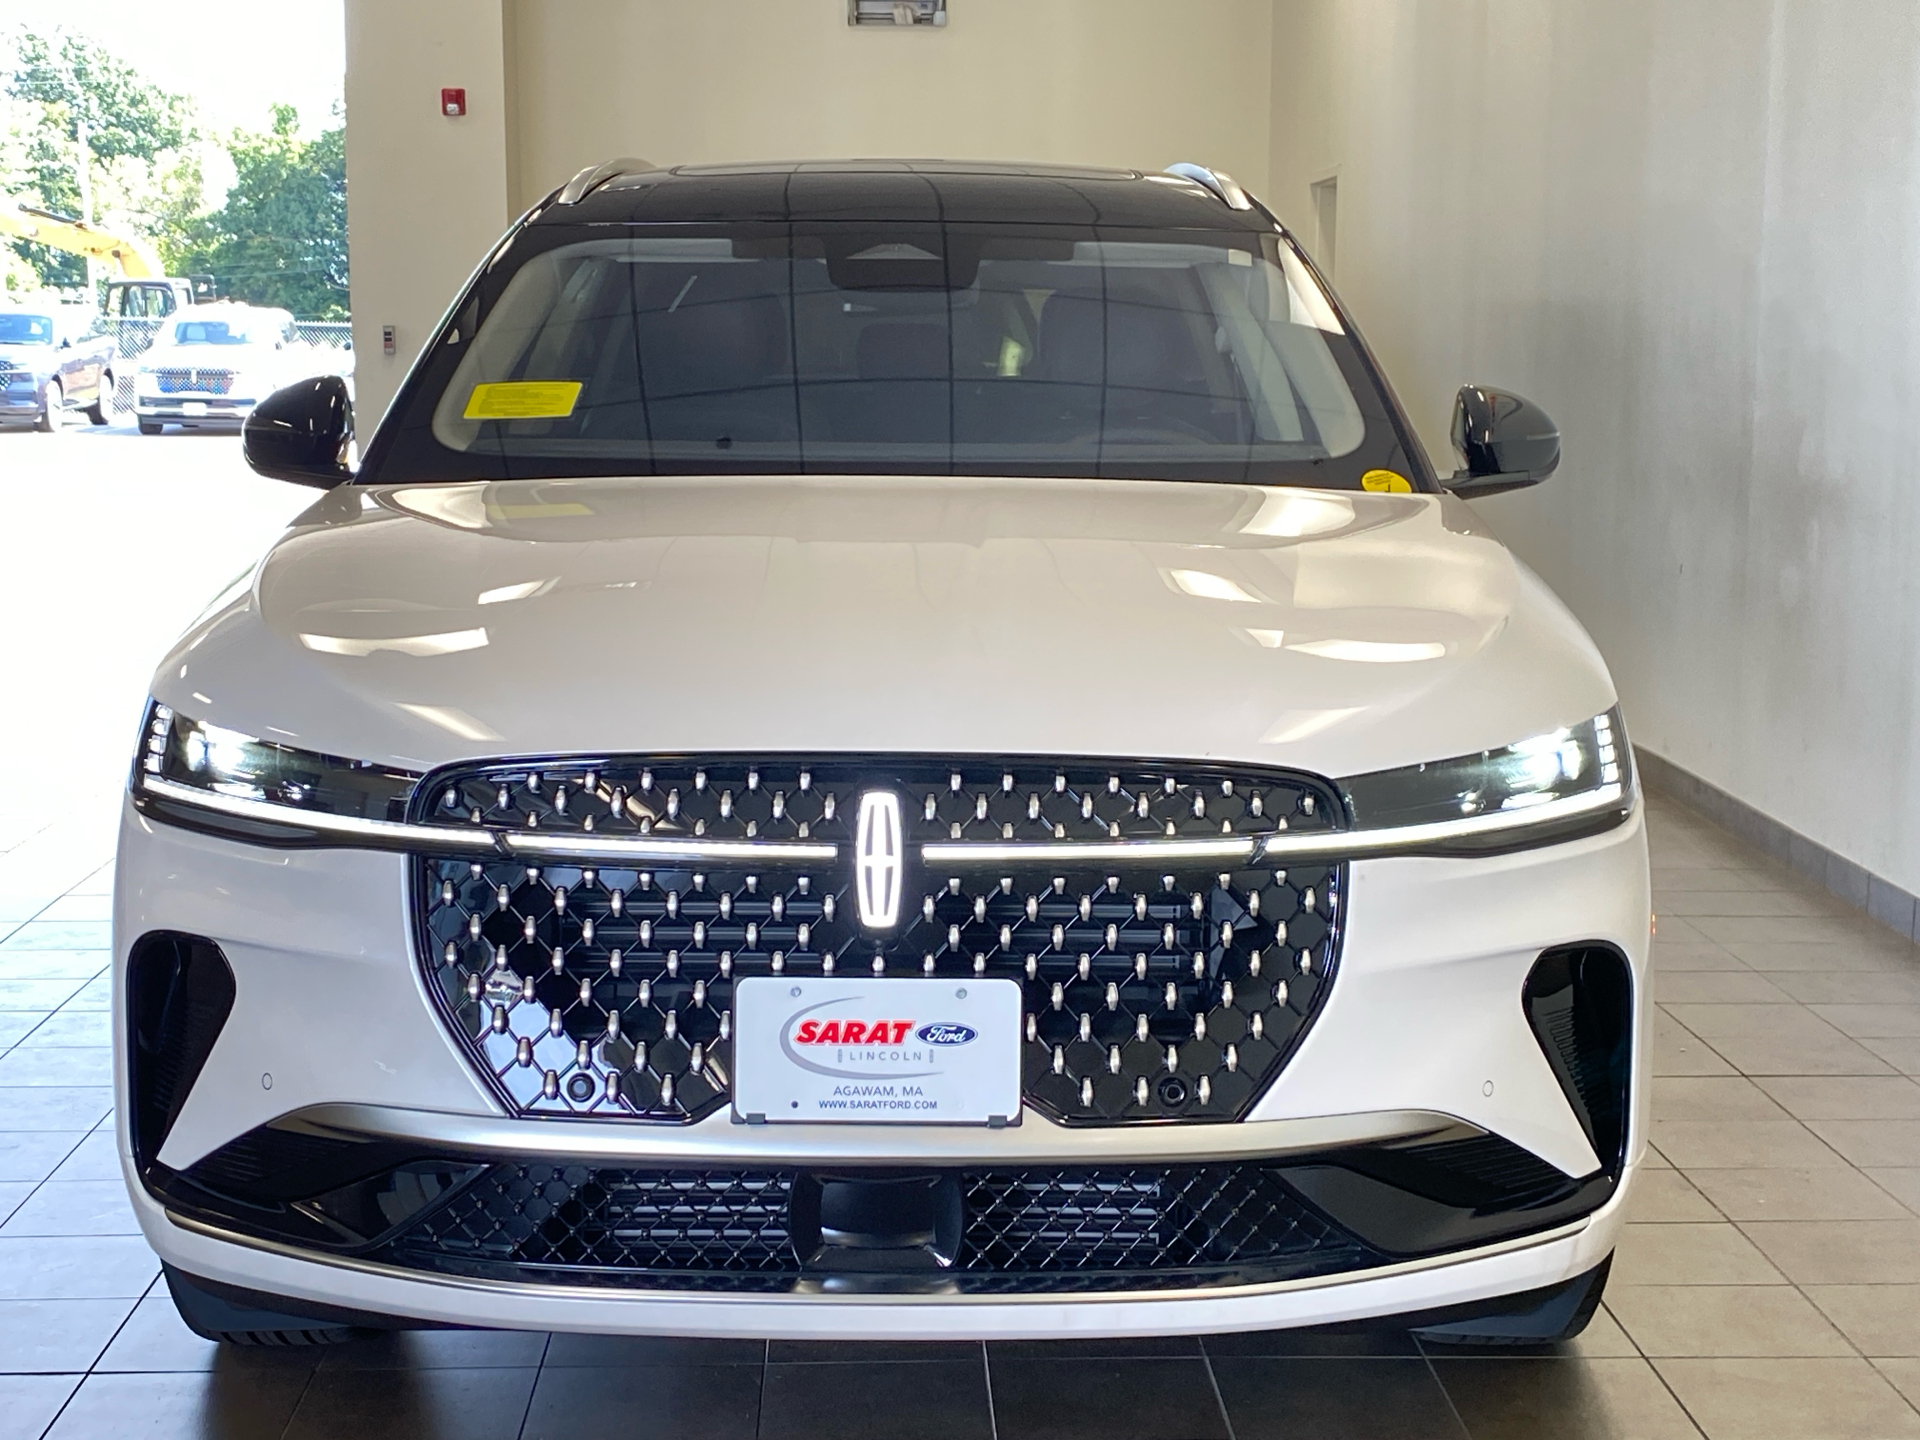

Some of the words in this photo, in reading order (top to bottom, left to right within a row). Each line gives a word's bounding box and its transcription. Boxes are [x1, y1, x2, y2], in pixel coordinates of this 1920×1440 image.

[794, 1019, 915, 1047] SARAT
[923, 1024, 969, 1044] Ford
[849, 1051, 922, 1062] LINCOLN
[833, 1085, 898, 1098] AGAWAM,
[902, 1085, 923, 1097] MA
[818, 1100, 938, 1110] WWW.SARATFORD.COM
